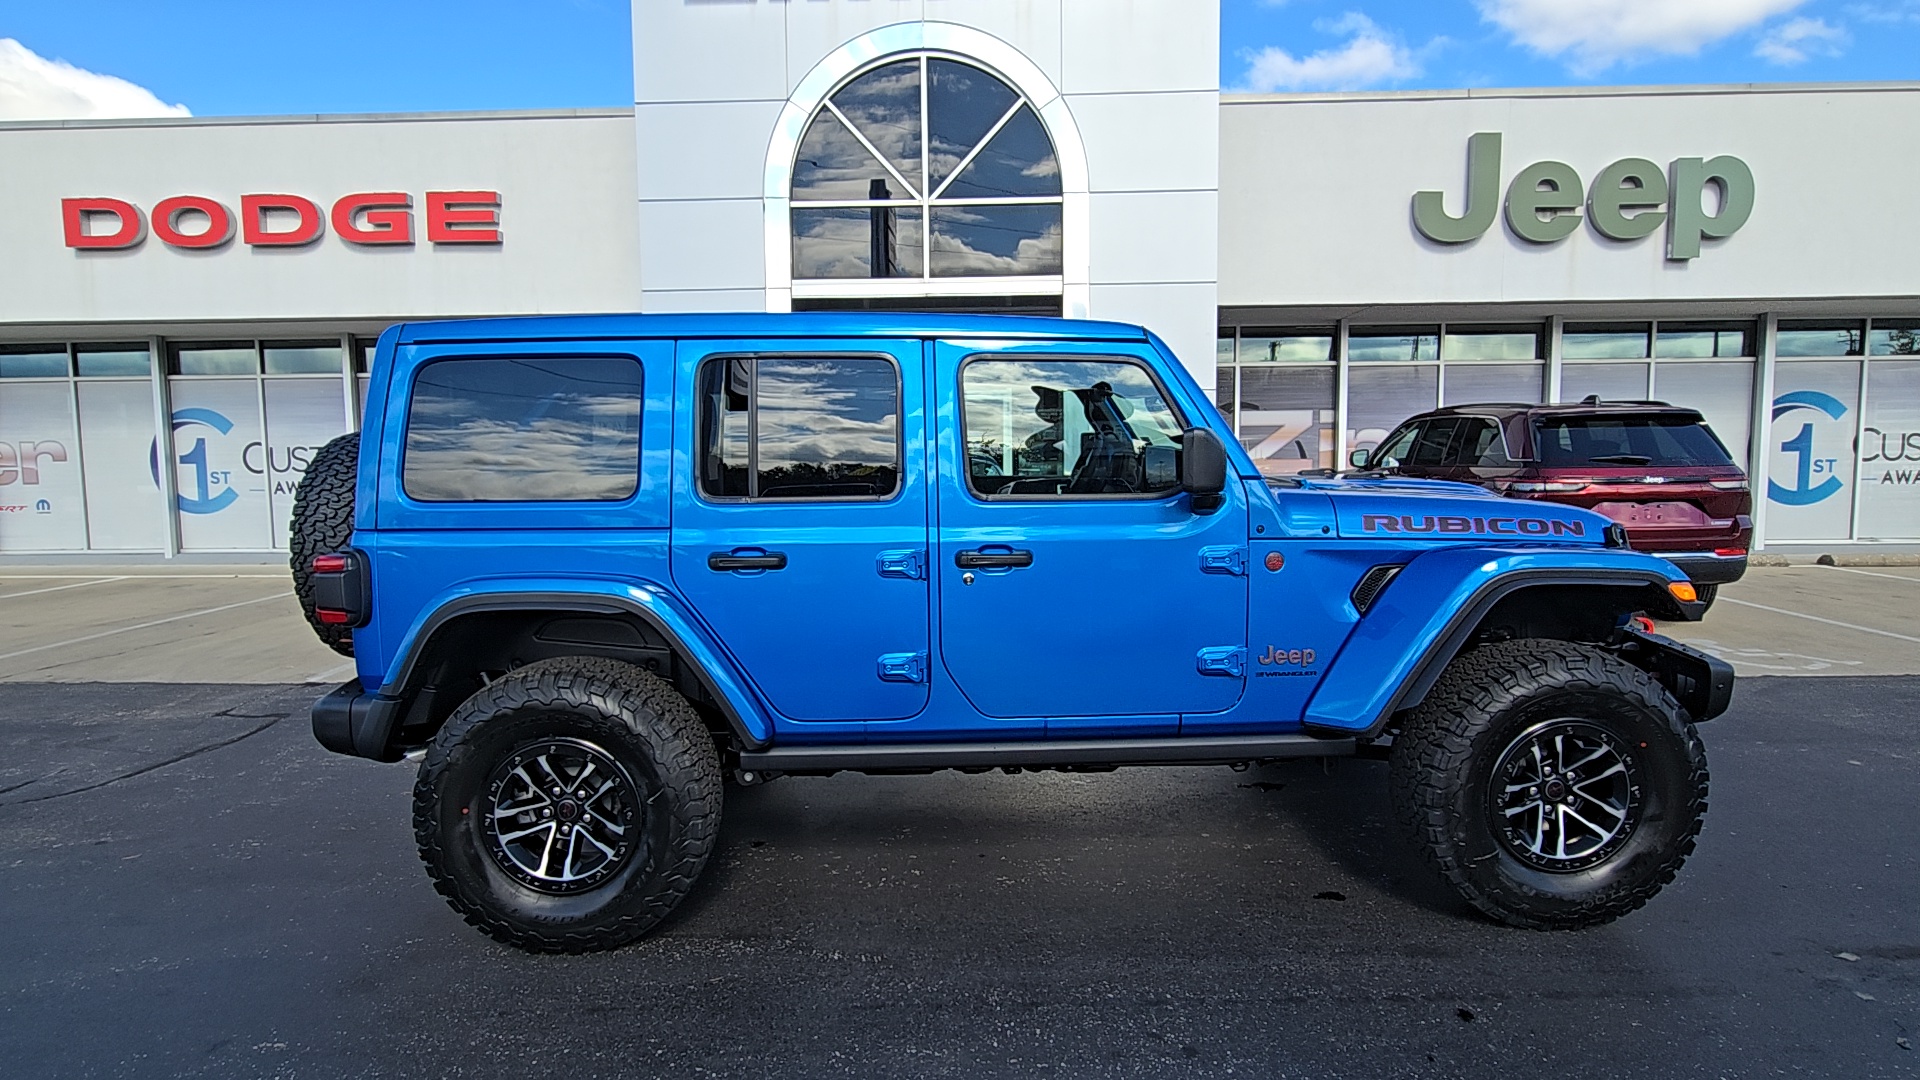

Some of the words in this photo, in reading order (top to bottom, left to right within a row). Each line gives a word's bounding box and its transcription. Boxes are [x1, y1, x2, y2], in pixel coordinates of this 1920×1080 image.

[1411, 131, 1756, 260] Jeep
[61, 190, 503, 249] DODGE
[1643, 475, 1665, 484] Jeep
[1362, 514, 1585, 537] RUBICON
[1258, 644, 1317, 668] Jeep
